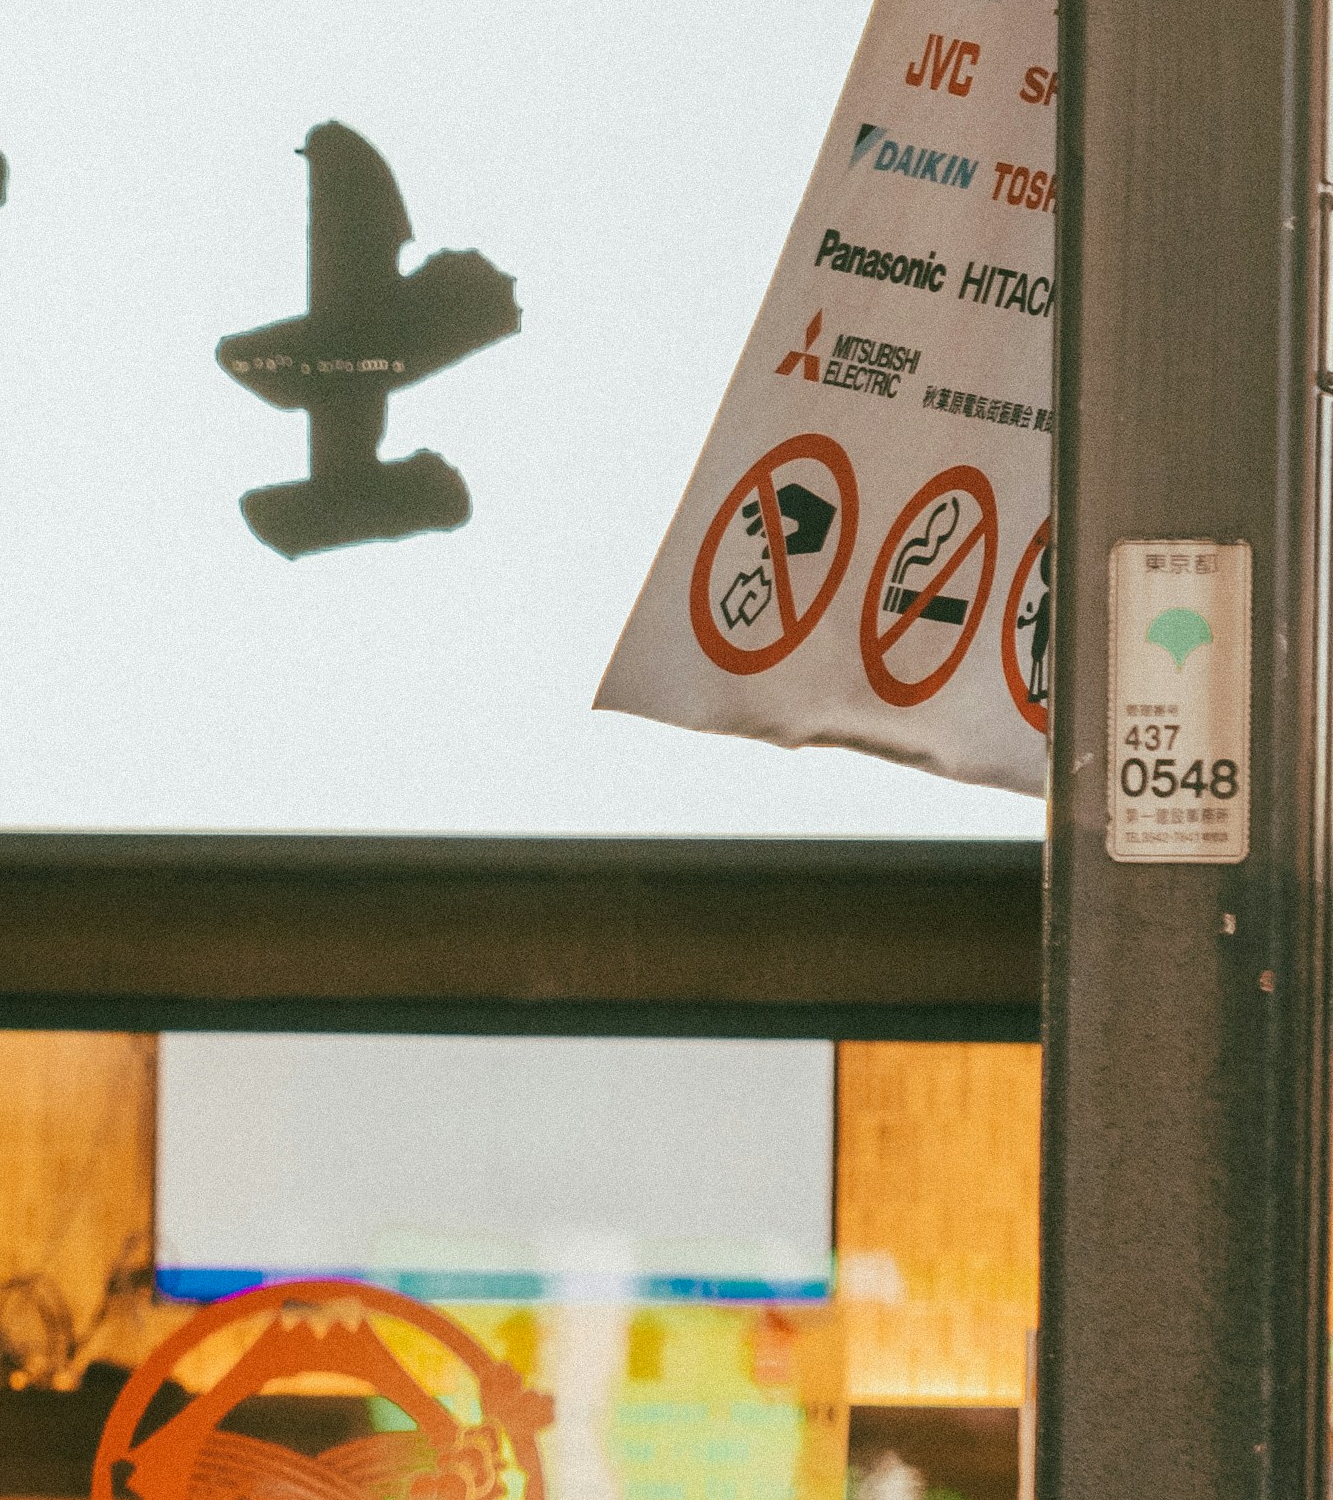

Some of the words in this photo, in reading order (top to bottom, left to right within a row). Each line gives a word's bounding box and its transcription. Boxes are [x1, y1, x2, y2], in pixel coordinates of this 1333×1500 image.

[904, 33, 981, 97] JVC
[873, 140, 979, 190] DAIKIN
[814, 229, 947, 294] Panasonic
[832, 334, 923, 374] MITSUBISHI
[822, 361, 902, 399] ELECTRIC
[1144, 553, 1220, 576] 東京都
[1124, 723, 1181, 752] 437
[1120, 757, 1240, 800] 0548
